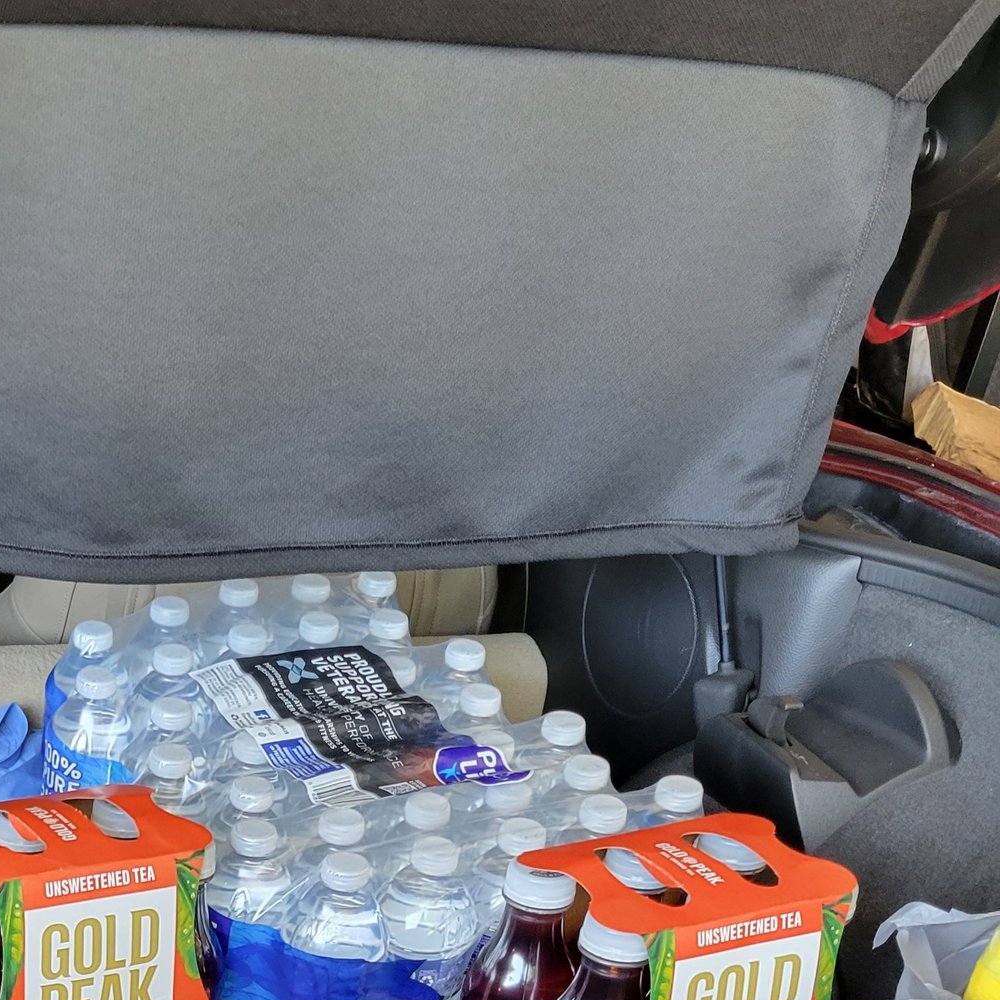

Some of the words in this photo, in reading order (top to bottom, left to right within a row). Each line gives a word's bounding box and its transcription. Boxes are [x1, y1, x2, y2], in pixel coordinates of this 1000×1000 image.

[343, 652, 394, 701] PROUDL
[317, 724, 338, 750] FITNESS
[358, 724, 374, 740] OF
[381, 719, 398, 740] THE
[45, 869, 131, 898] UNSWEETENED
[132, 865, 156, 884] TEA
[655, 842, 688, 858] GOLD
[689, 863, 725, 887] PEAK
[41, 908, 160, 981] GOLD
[697, 916, 778, 947] UNSWEETENED
[780, 911, 802, 930] TEA
